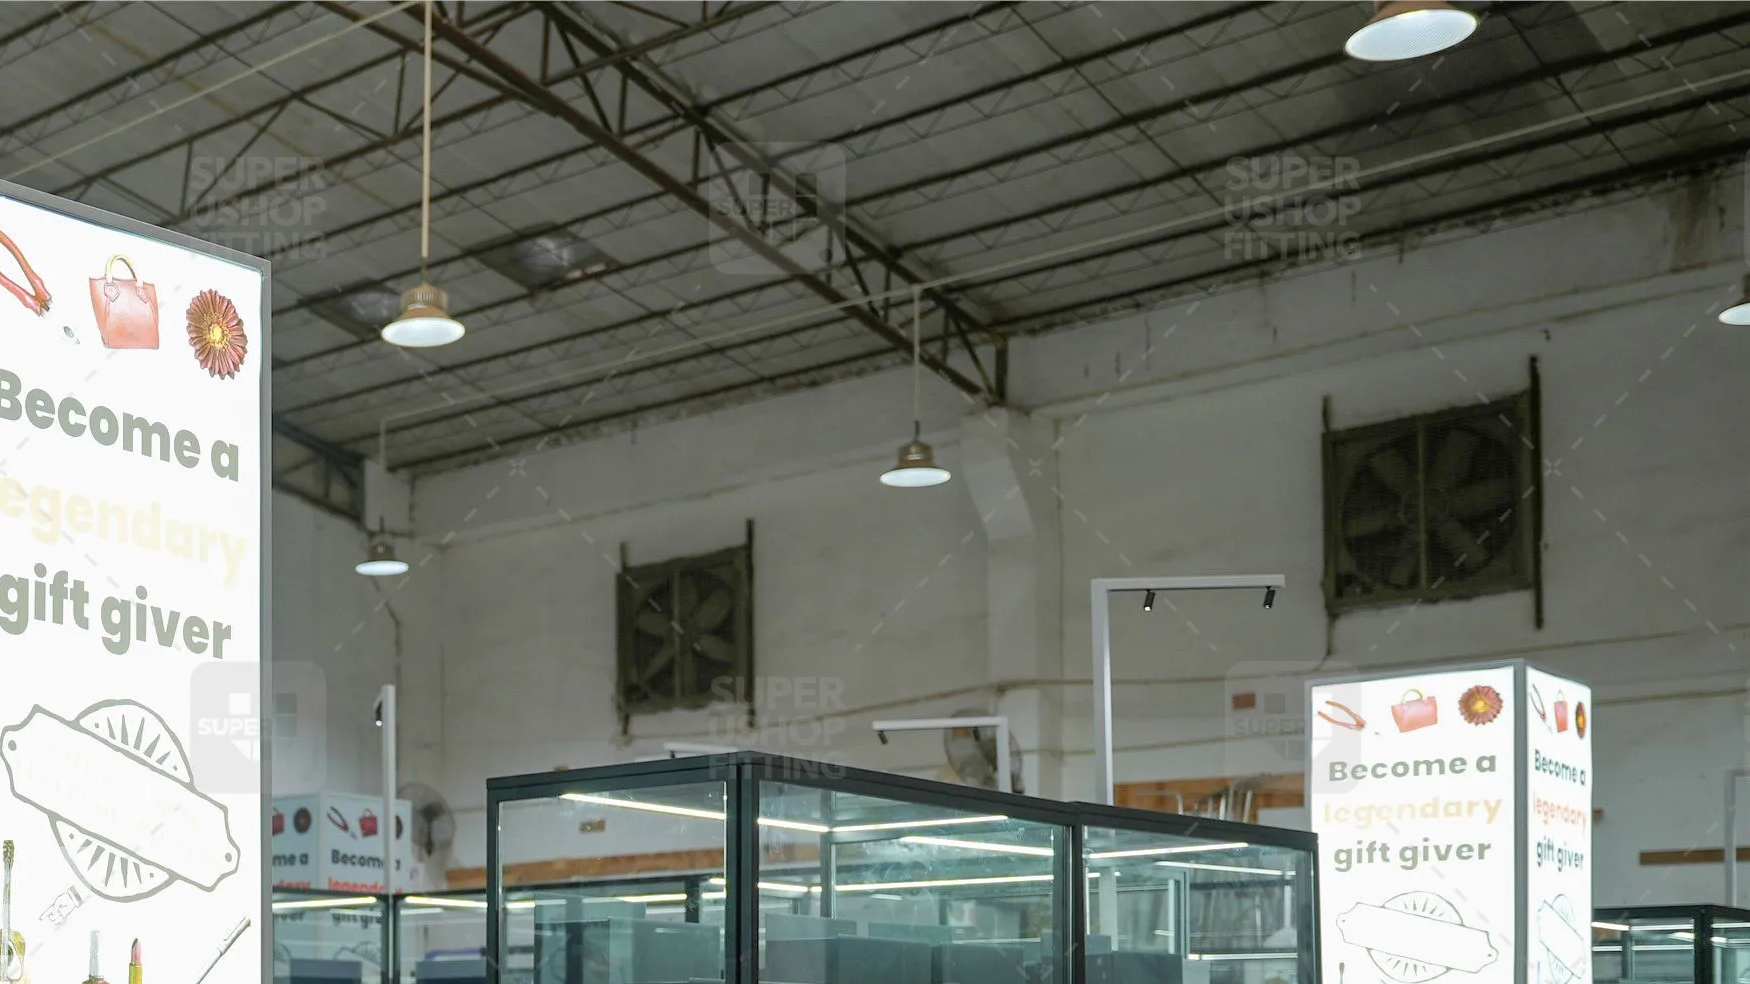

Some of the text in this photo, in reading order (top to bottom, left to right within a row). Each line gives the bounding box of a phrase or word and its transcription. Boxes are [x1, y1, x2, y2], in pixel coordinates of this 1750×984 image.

[211, 440, 238, 482] a
[101, 585, 231, 659] giver
[1329, 755, 1497, 781] Become a
[1534, 749, 1586, 786] Become a
[1324, 797, 1503, 829] legendary
[1533, 792, 1588, 837] legendary
[331, 848, 384, 869] Becom
[1334, 837, 1492, 873] gift giver
[1536, 835, 1585, 872] gift giver
